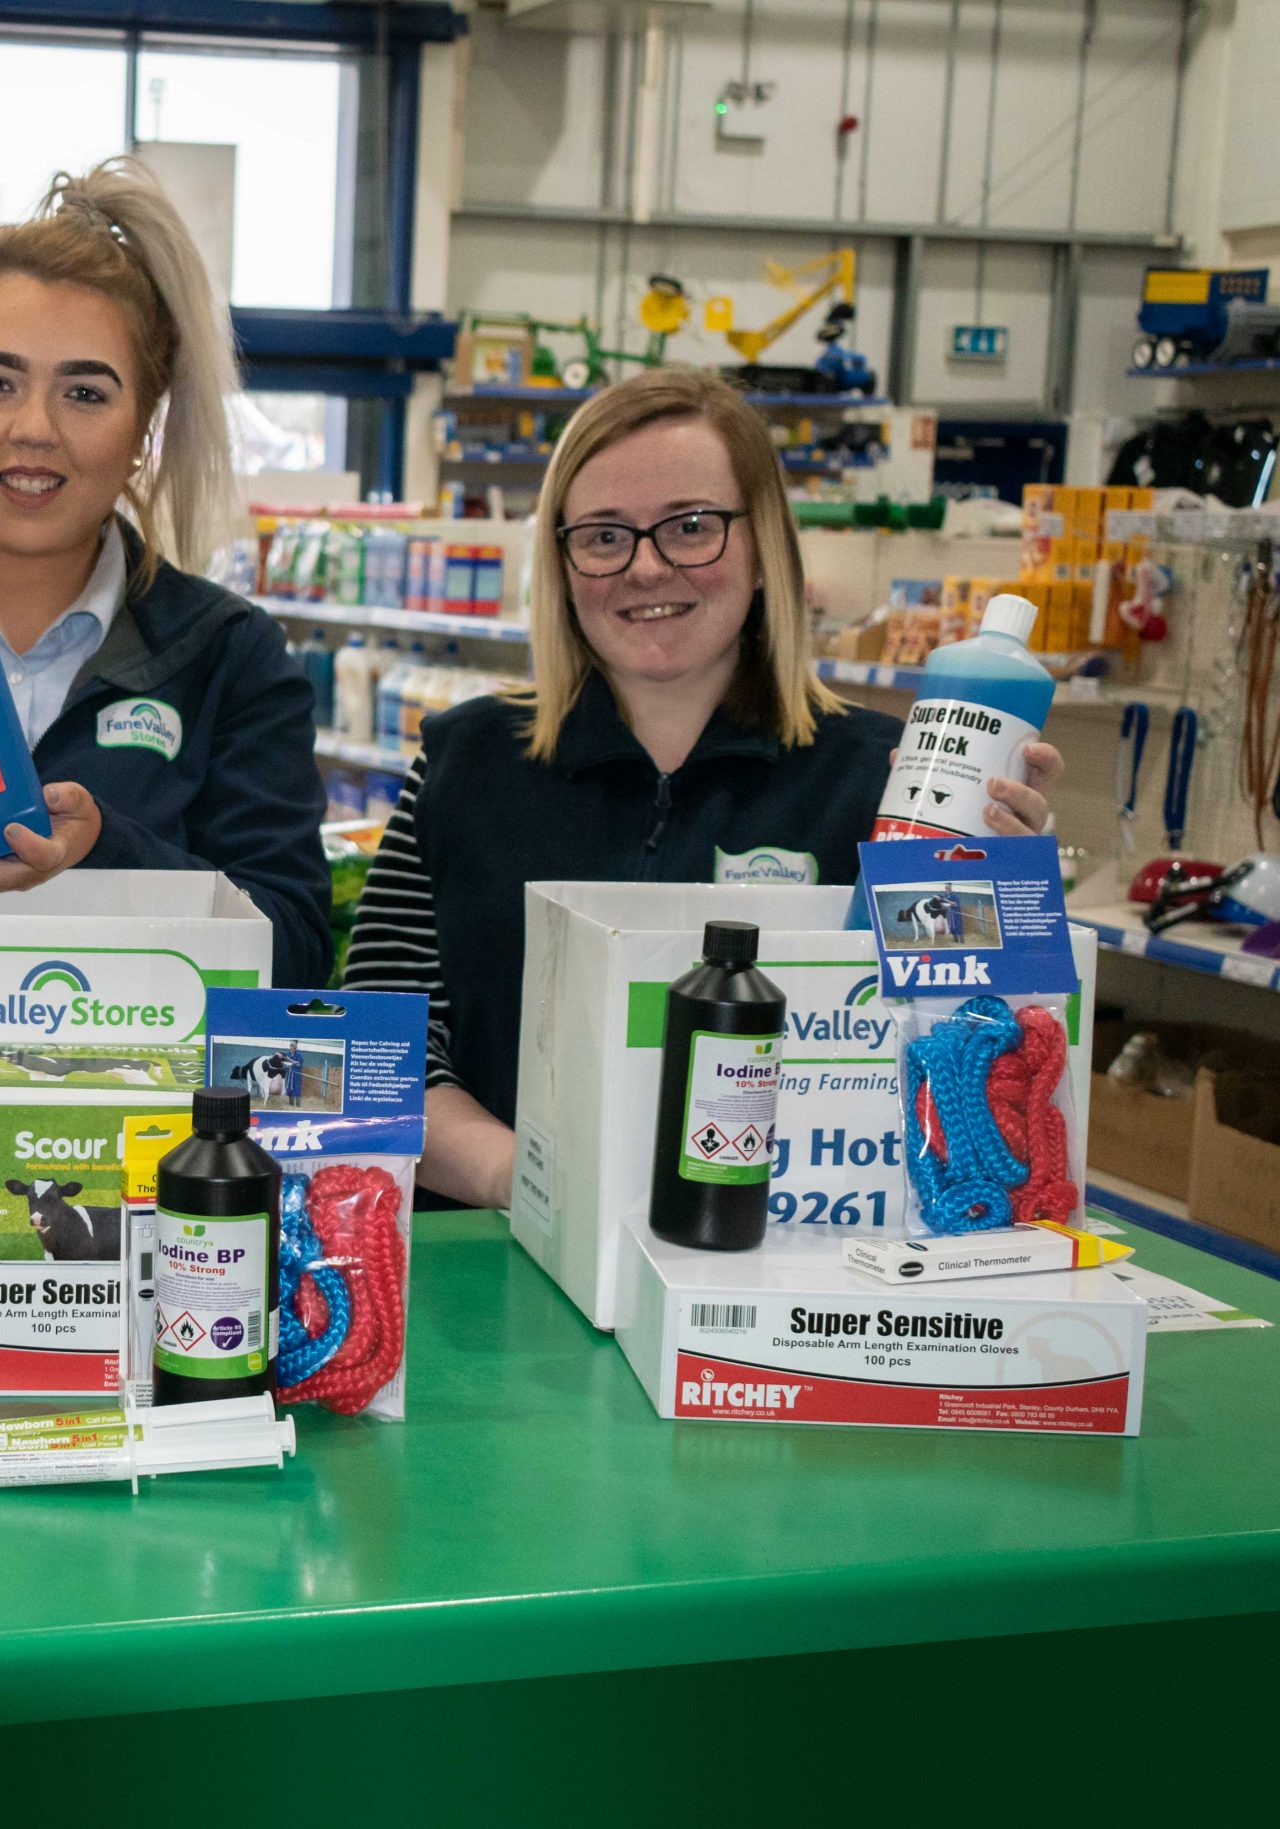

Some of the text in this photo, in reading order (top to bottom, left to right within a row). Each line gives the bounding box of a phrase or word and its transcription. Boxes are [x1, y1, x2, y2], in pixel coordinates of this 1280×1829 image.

[910, 705, 1002, 736] Superlube
[917, 731, 969, 757] Thick
[949, 760, 982, 773] purpose
[940, 767, 982, 785] husbandry
[887, 954, 992, 987] Vink
[717, 1063, 772, 1079] Iodine
[247, 1116, 323, 1151] ink
[14, 1131, 108, 1160] Scour
[26, 1162, 90, 1171] Formulated with
[158, 1239, 246, 1264] Iodine BP
[855, 1248, 878, 1262] Clinical
[168, 1260, 226, 1276] 10% Strong
[847, 1253, 886, 1274] Thermometer
[938, 1255, 1032, 1271] Clinical Thermometer
[43, 1279, 120, 1305] Sensit
[5, 1309, 28, 1318] Arm
[31, 1309, 69, 1319] Length
[72, 1309, 120, 1318] Examinat
[31, 1323, 77, 1334] 100 pcs
[790, 1307, 1004, 1340] Super Sensitive
[772, 1338, 1019, 1355] Disposable Arm Length Examination Gloves
[864, 1355, 911, 1368] 100 pcs
[682, 1381, 802, 1409] RITCHEY
[939, 1393, 963, 1401] Ritchey
[712, 1408, 776, 1417] www.ritchey.co.uk
